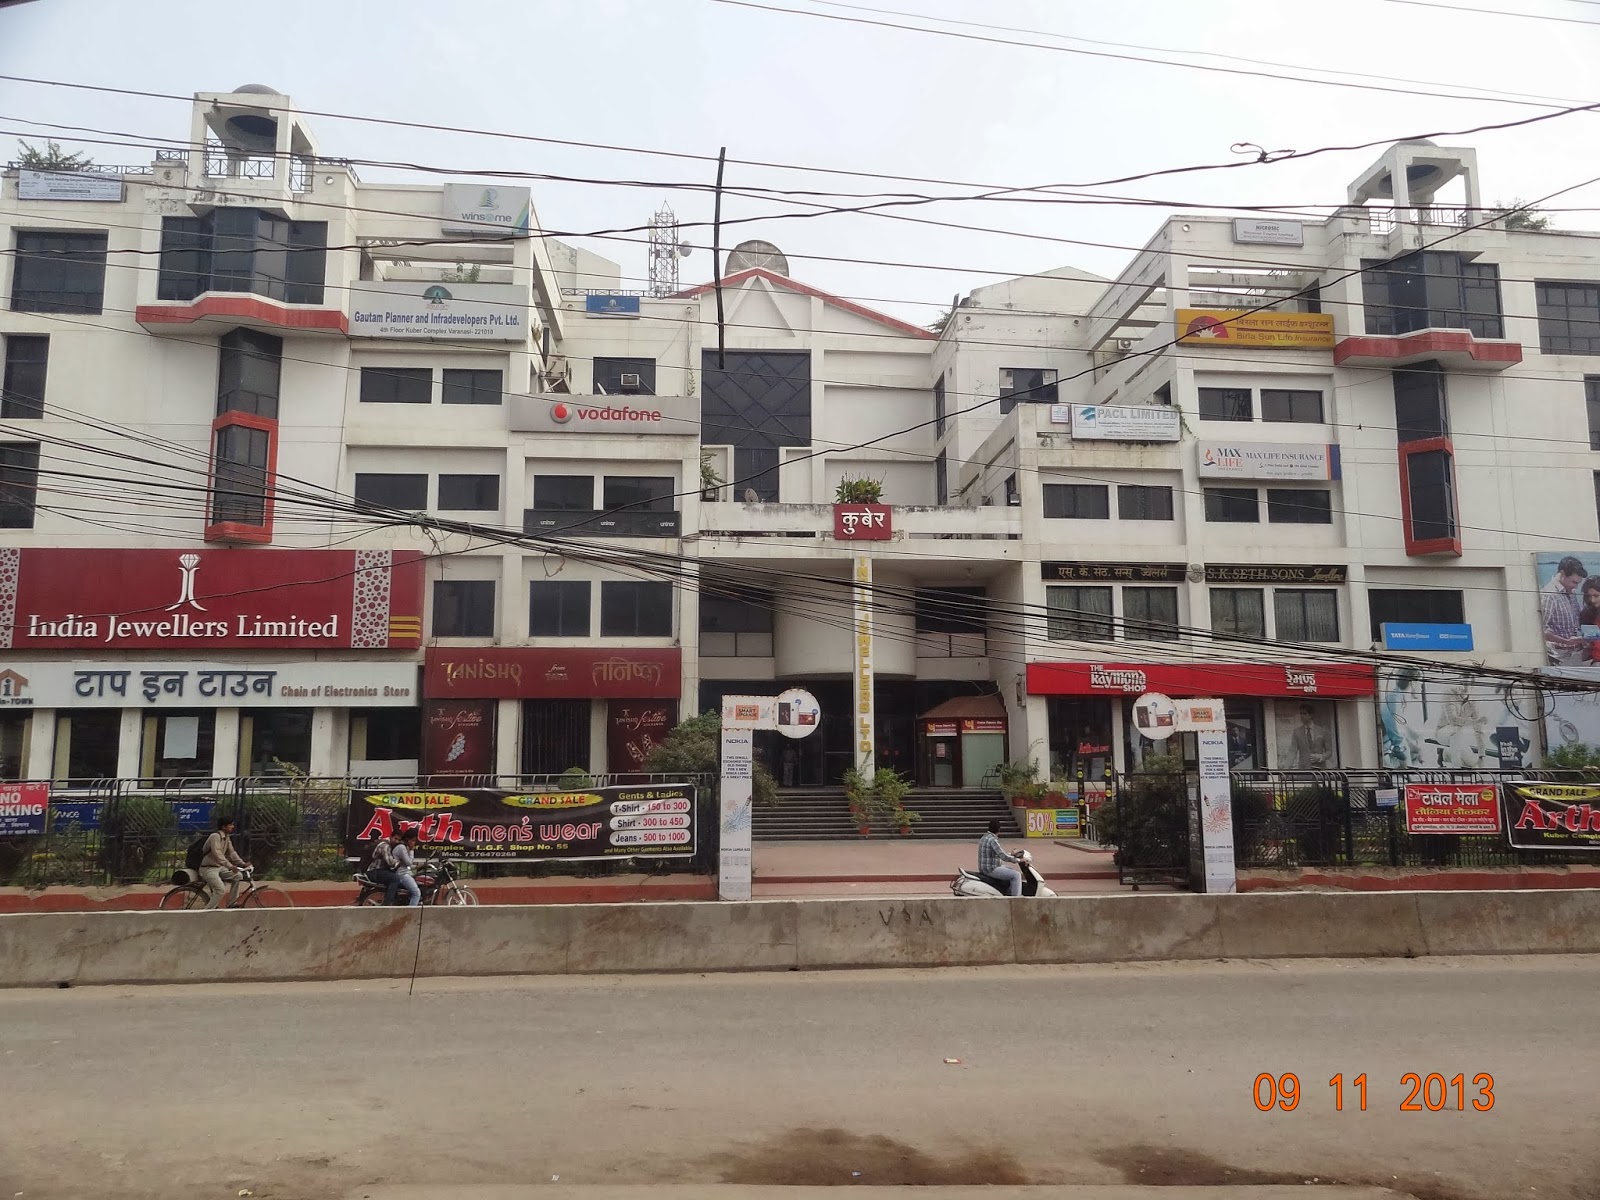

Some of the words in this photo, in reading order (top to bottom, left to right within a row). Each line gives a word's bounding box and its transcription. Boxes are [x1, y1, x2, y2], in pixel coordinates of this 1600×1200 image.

[462, 212, 512, 222] winsome
[355, 312, 383, 323] Gautam
[385, 313, 414, 324] Planner
[415, 314, 429, 325] and
[430, 314, 488, 327] Infradevelopers
[489, 315, 504, 326] Pvt.
[505, 316, 520, 327] Ltd.
[424, 328, 448, 336] Complex
[1258, 333, 1276, 341] Sun
[1295, 334, 1331, 342] Insurance
[577, 407, 662, 422] vodafone
[1097, 409, 1127, 419] PACL
[1130, 410, 1178, 420] LIMITED
[1217, 448, 1242, 457] MAX
[1263, 452, 1280, 460] LIFE
[1281, 453, 1325, 461] INSURANCE
[1217, 458, 1244, 467] LIFE
[841, 507, 886, 534] कुबेर
[27, 614, 99, 638] India
[105, 614, 229, 643] Jewellers
[236, 614, 339, 638] Limited
[74, 671, 132, 698] टाप
[140, 671, 189, 703] इन
[197, 671, 278, 699] टाउन
[281, 684, 309, 698] Chain
[311, 684, 322, 698] of
[323, 684, 379, 698] Electronics
[382, 684, 411, 698] Store
[619, 792, 645, 800] Gents
[646, 791, 654, 799] &
[657, 789, 682, 798] Ladies
[1454, 787, 1479, 806] मेला
[1529, 788, 1563, 796] GRAND
[0, 792, 21, 804] NO
[382, 796, 422, 805] GRAND
[424, 796, 450, 805] SALE
[518, 796, 557, 805] GRAND
[560, 795, 586, 804] SALE
[613, 804, 640, 813] T-Shirt
[663, 802, 672, 810] to
[673, 802, 688, 810] 300
[1514, 799, 1600, 832] Arth
[357, 808, 464, 842] Arth
[540, 823, 602, 842] wear
[617, 819, 636, 828] Shirt
[642, 818, 658, 826] 300
[659, 818, 668, 826] to
[669, 818, 684, 826] 450
[1028, 812, 1054, 832] 50%
[615, 834, 637, 843] Jeans
[643, 833, 658, 842] 500
[659, 833, 667, 841] to
[668, 833, 685, 841] 1000
